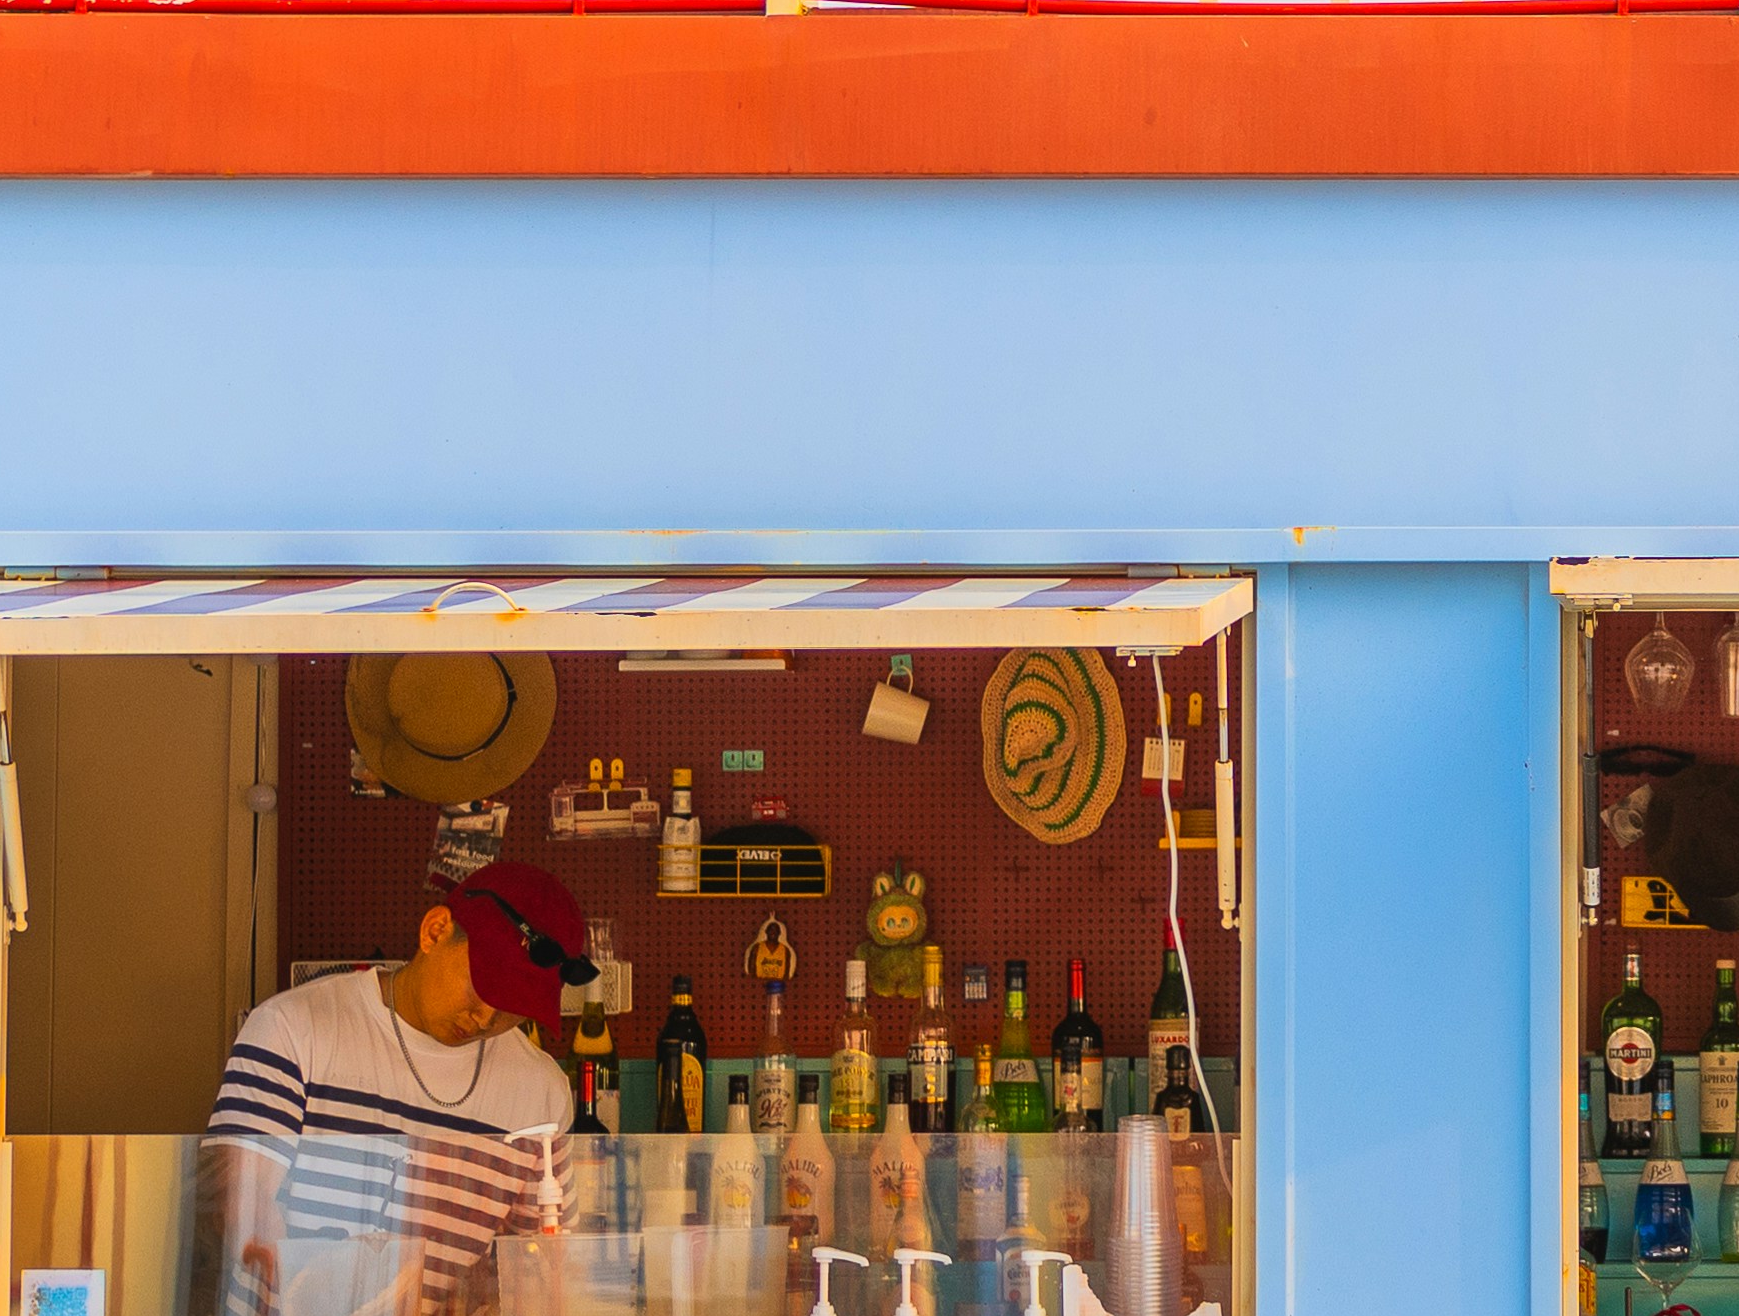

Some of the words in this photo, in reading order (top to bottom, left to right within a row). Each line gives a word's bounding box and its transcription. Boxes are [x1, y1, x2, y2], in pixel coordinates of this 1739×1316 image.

[906, 1047, 953, 1062] CAMPARI
[1609, 1048, 1651, 1058] MARTINI
[1715, 1097, 1729, 1109] 10
[714, 1159, 762, 1179] MALIBU
[780, 1158, 822, 1179] MALIBU
